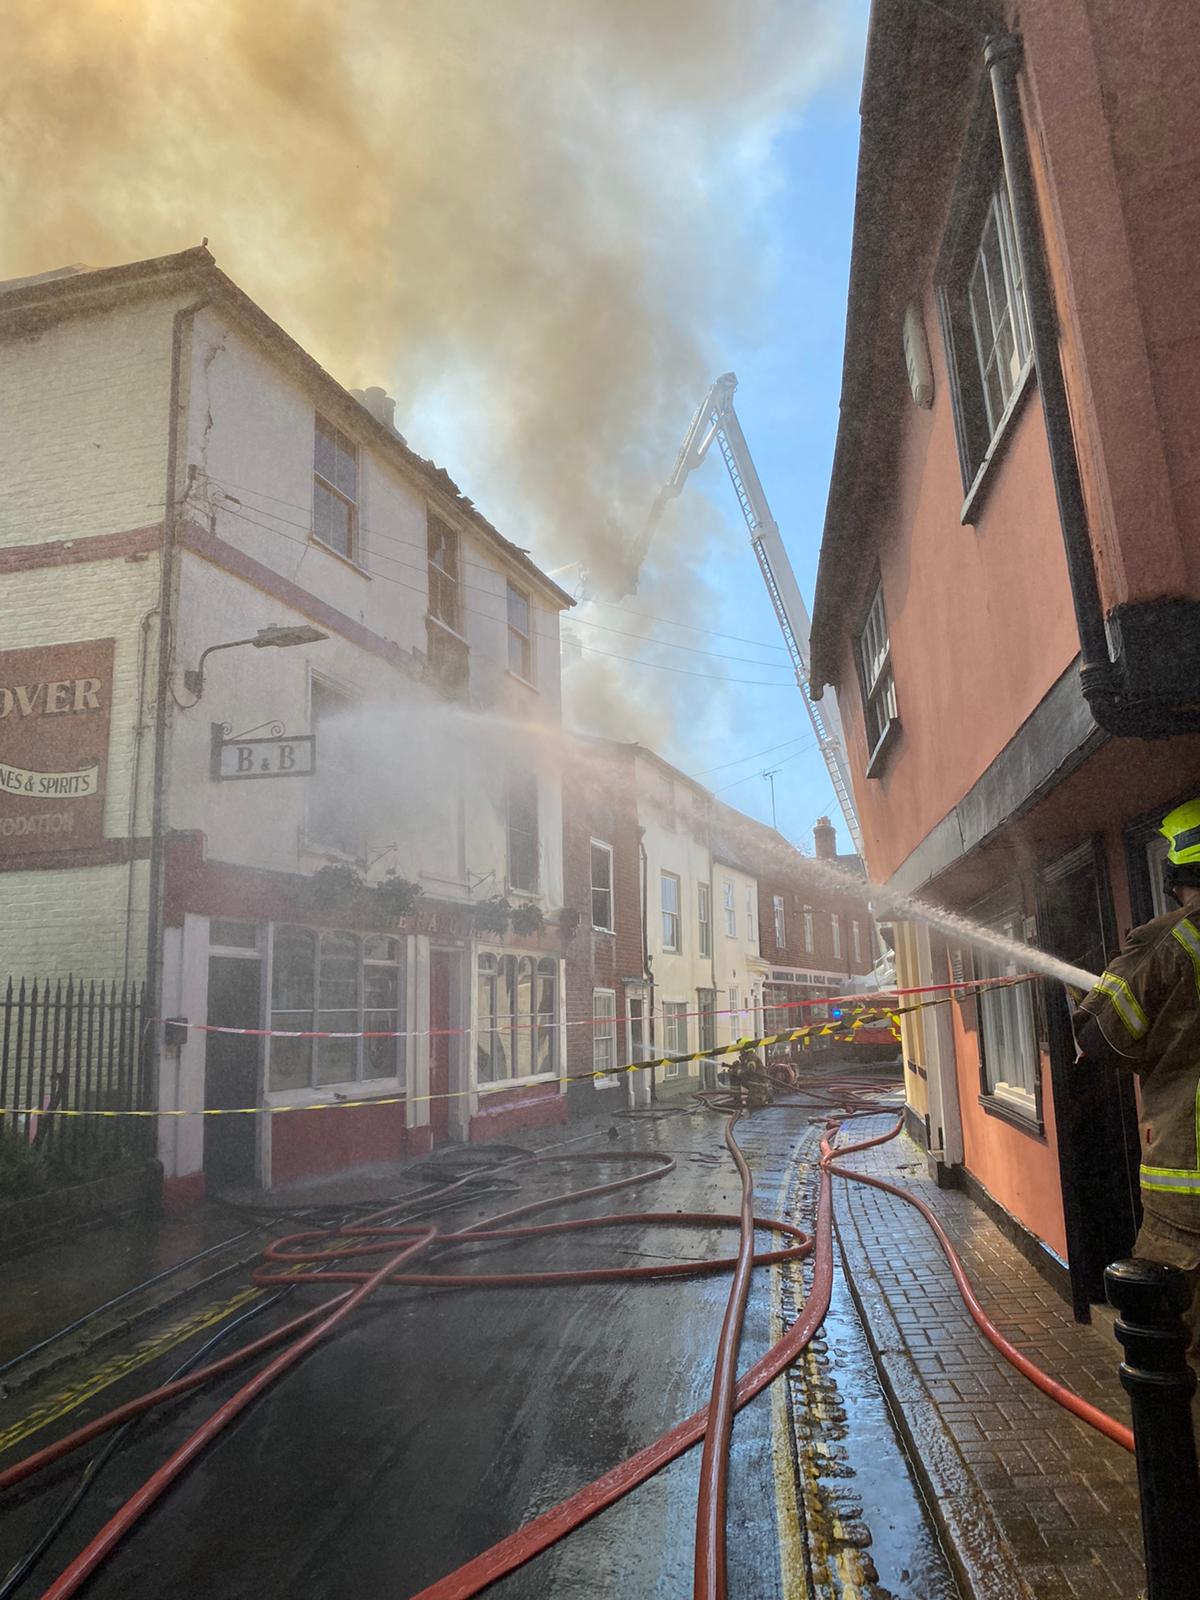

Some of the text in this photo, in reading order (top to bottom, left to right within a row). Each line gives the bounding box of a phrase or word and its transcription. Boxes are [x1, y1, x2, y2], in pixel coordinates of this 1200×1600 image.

[24, 775, 35, 792] &
[39, 774, 90, 793] SPIRITS
[0, 813, 74, 836] ODATION
